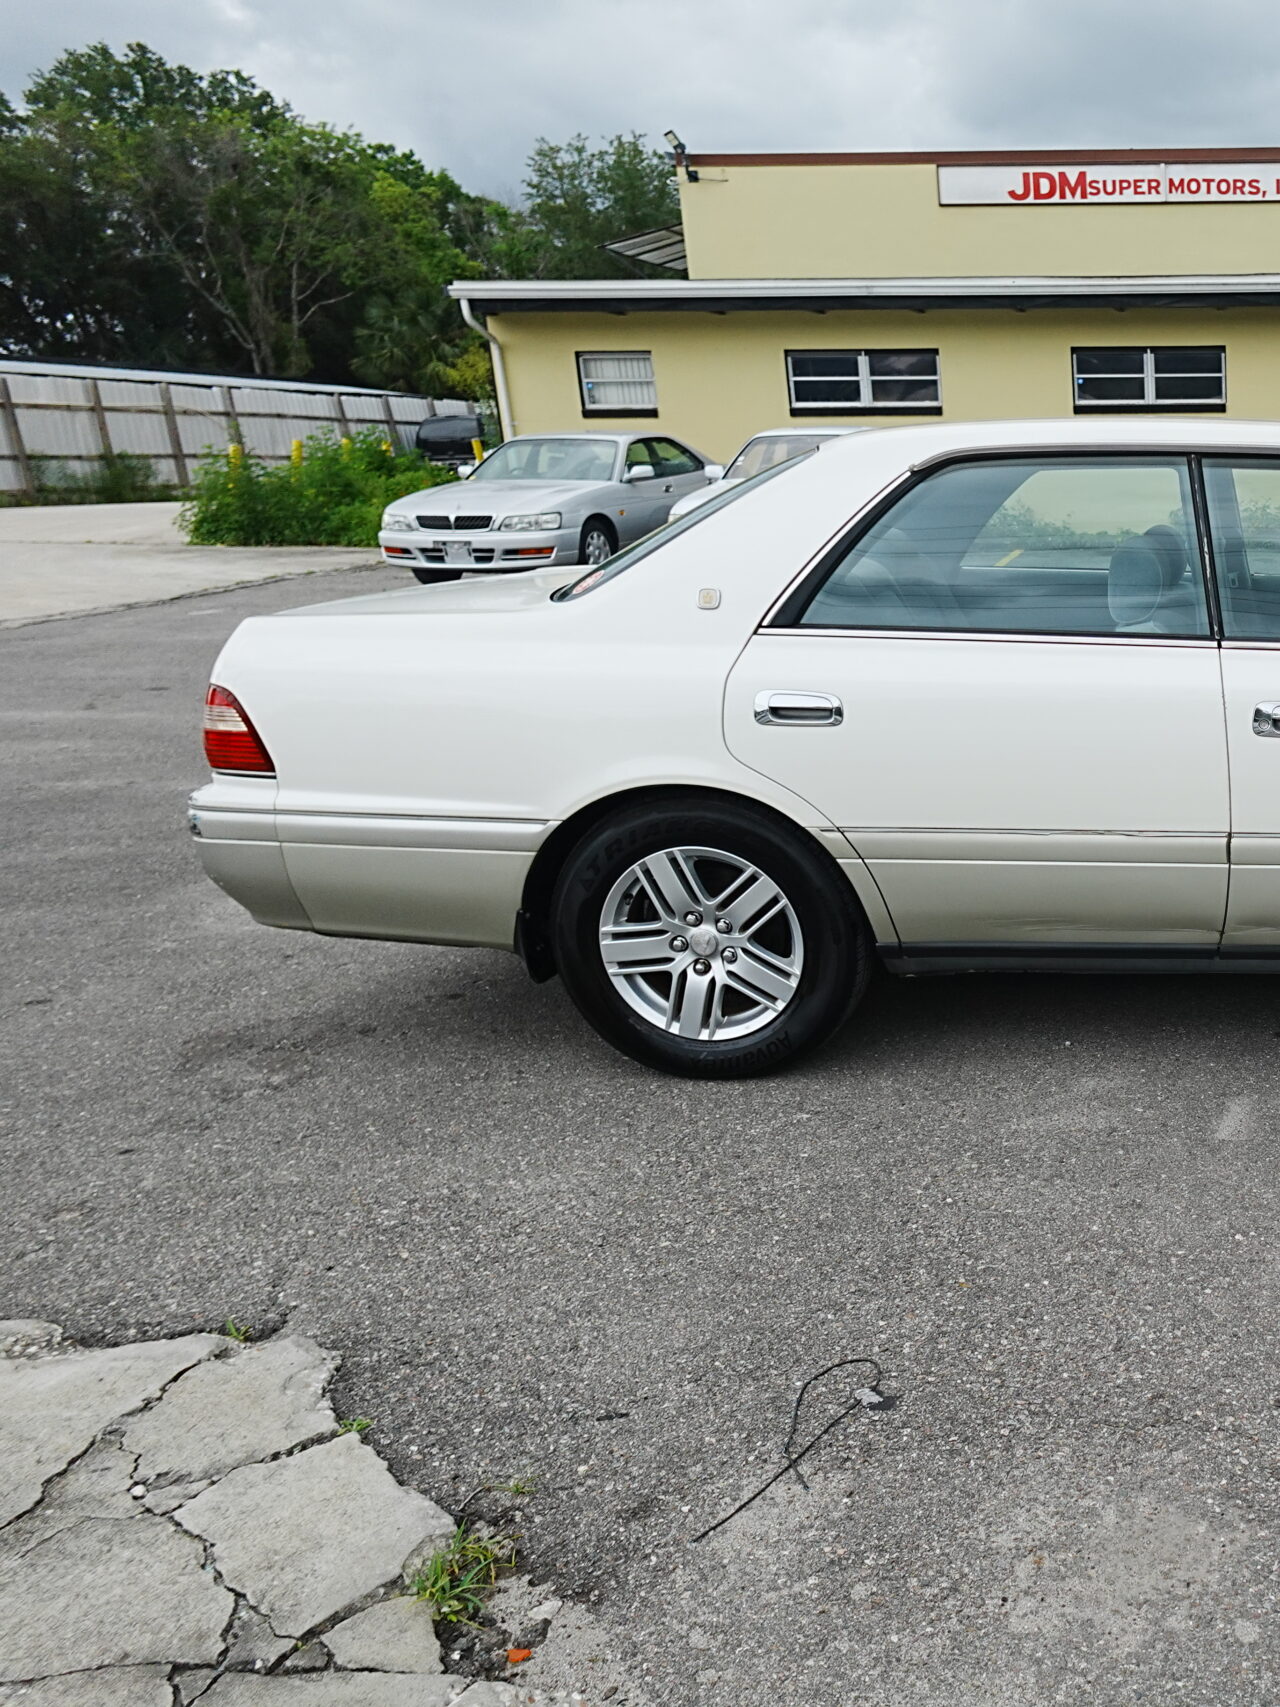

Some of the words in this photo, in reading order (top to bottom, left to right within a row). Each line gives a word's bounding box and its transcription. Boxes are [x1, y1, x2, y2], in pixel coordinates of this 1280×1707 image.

[1007, 171, 1088, 201] JDM
[1088, 179, 1161, 196] SUPER
[1168, 178, 1267, 198] MOTORS,
